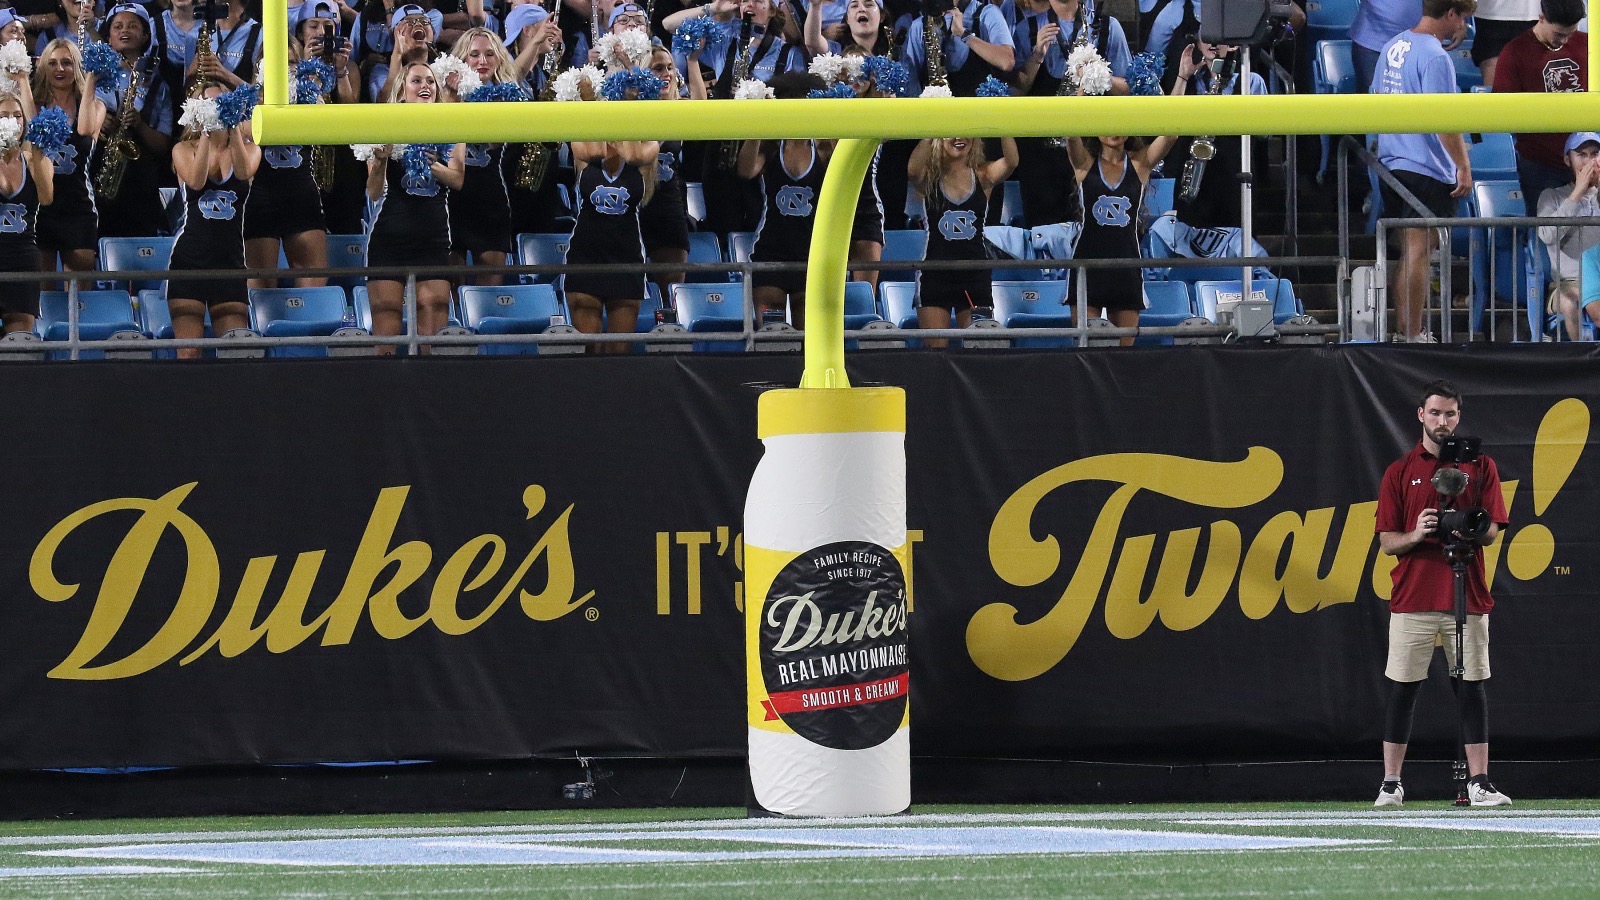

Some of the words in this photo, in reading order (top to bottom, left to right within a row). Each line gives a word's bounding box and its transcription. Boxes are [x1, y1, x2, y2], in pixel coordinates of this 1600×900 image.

[813, 552, 850, 569] FAMILY
[853, 551, 883, 568] RECIPE
[827, 567, 854, 581] SINCE
[856, 567, 872, 579] 1917
[28, 481, 596, 681] Duke's
[766, 588, 908, 653] Duke's
[778, 658, 820, 686] REAL
[821, 643, 907, 678] MAYONNAISE
[802, 687, 851, 708] SMOOTH
[854, 687, 863, 702] &
[866, 679, 900, 700] CREAMY
